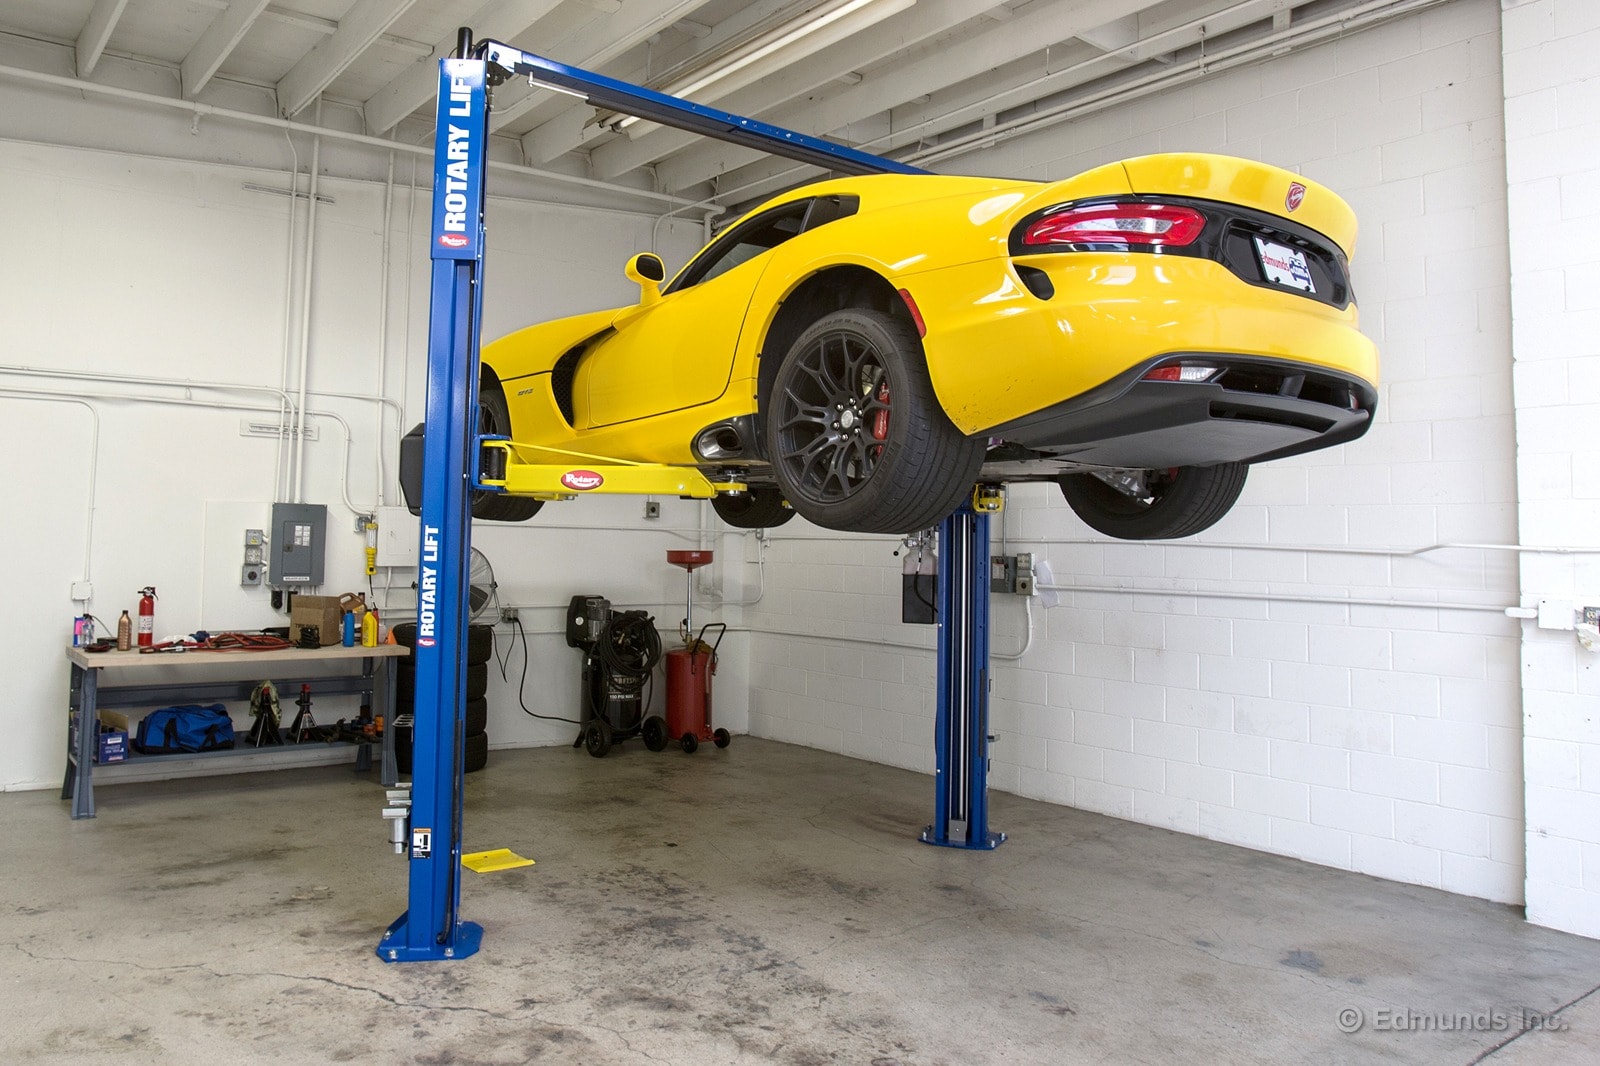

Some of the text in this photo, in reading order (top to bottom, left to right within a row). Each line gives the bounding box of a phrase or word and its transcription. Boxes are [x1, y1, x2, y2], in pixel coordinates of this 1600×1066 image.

[444, 72, 472, 232] ROTARY LIF
[566, 473, 599, 487] Rotary
[423, 524, 439, 561] LIFT
[420, 566, 437, 636] ROTARY
